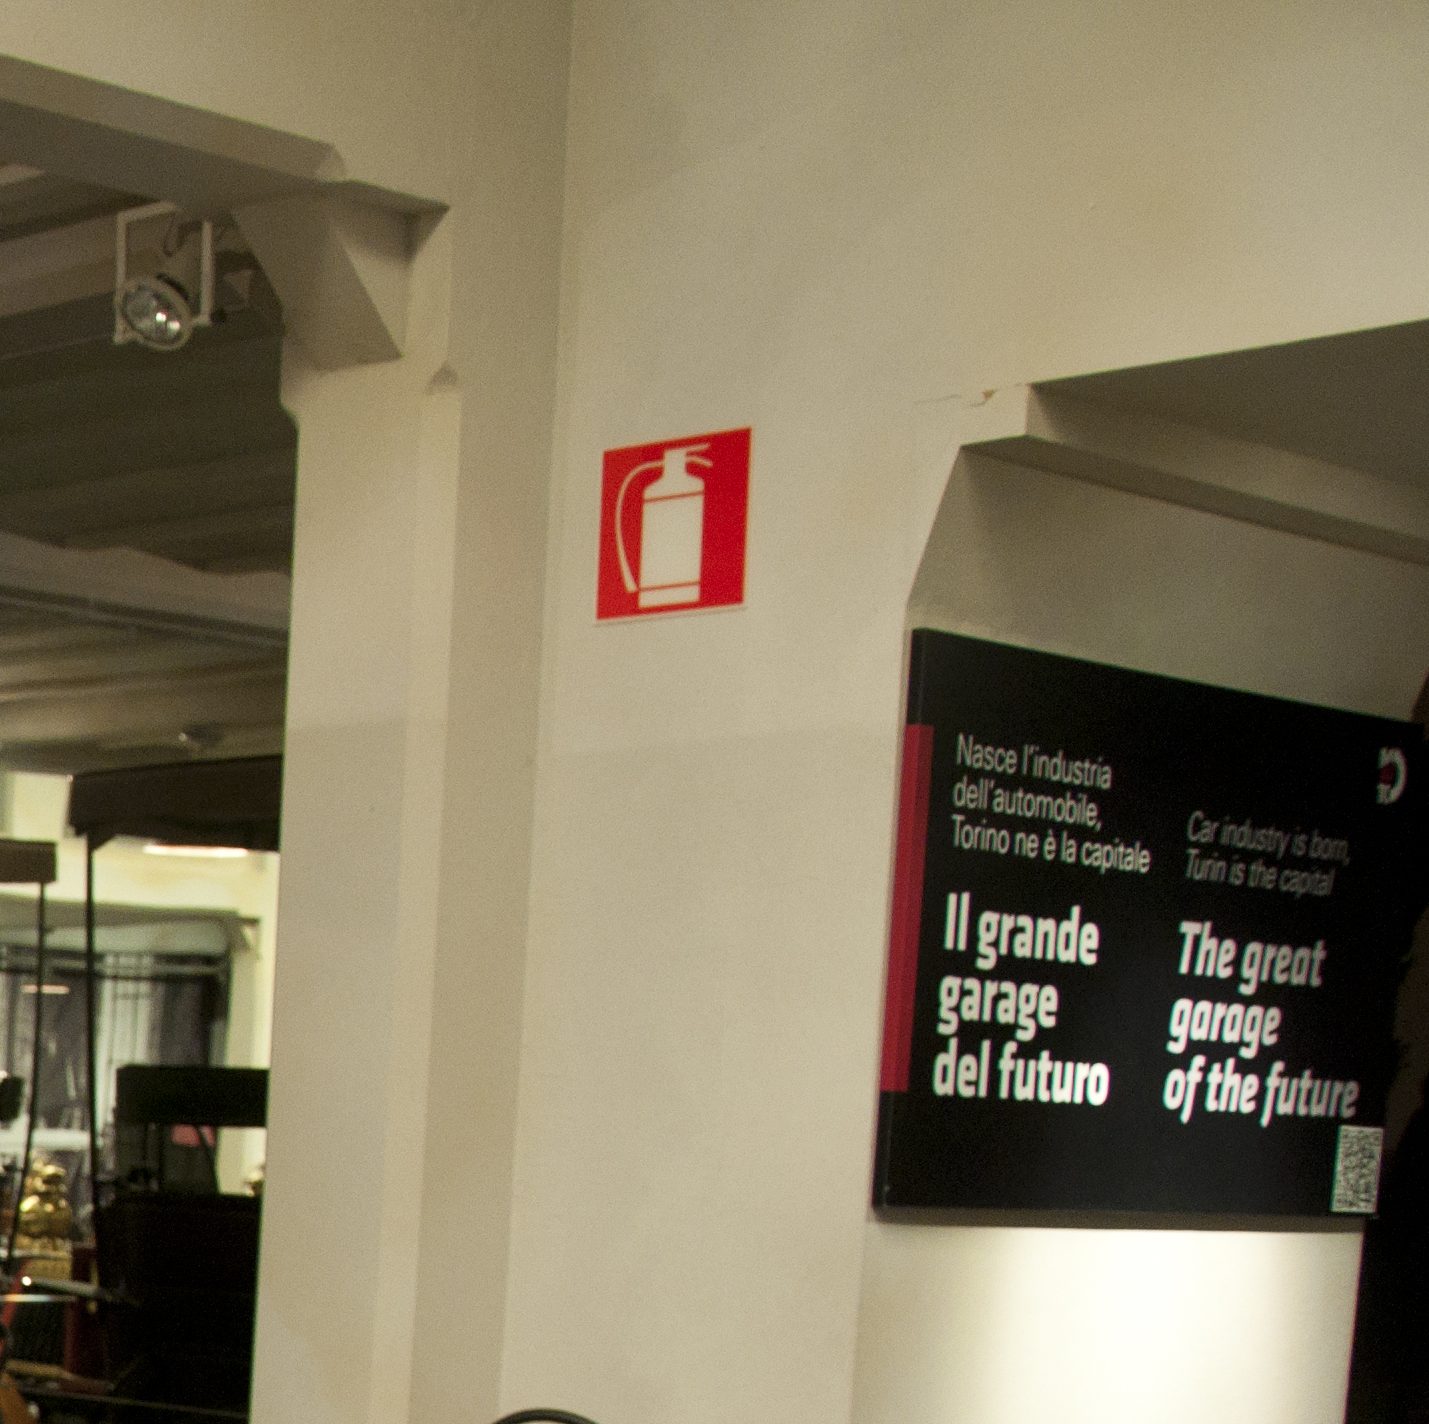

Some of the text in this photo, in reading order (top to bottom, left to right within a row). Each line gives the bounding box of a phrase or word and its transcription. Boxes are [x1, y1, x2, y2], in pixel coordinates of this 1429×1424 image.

[956, 732, 1113, 790] Nasce l'industria
[952, 775, 1102, 833] dell'automobile,
[951, 814, 1152, 875] Torino ne è la capitale
[1187, 810, 1220, 842] Car
[1220, 815, 1291, 860] industry
[1292, 825, 1309, 857] is
[1186, 848, 1336, 899] Turin is the capital
[944, 891, 1100, 971] Il grande
[1178, 920, 1327, 996] The great
[936, 975, 1059, 1042] garage
[1166, 998, 1282, 1059] garage
[932, 1037, 1110, 1106] del futuro
[1163, 1054, 1360, 1128] of the future
